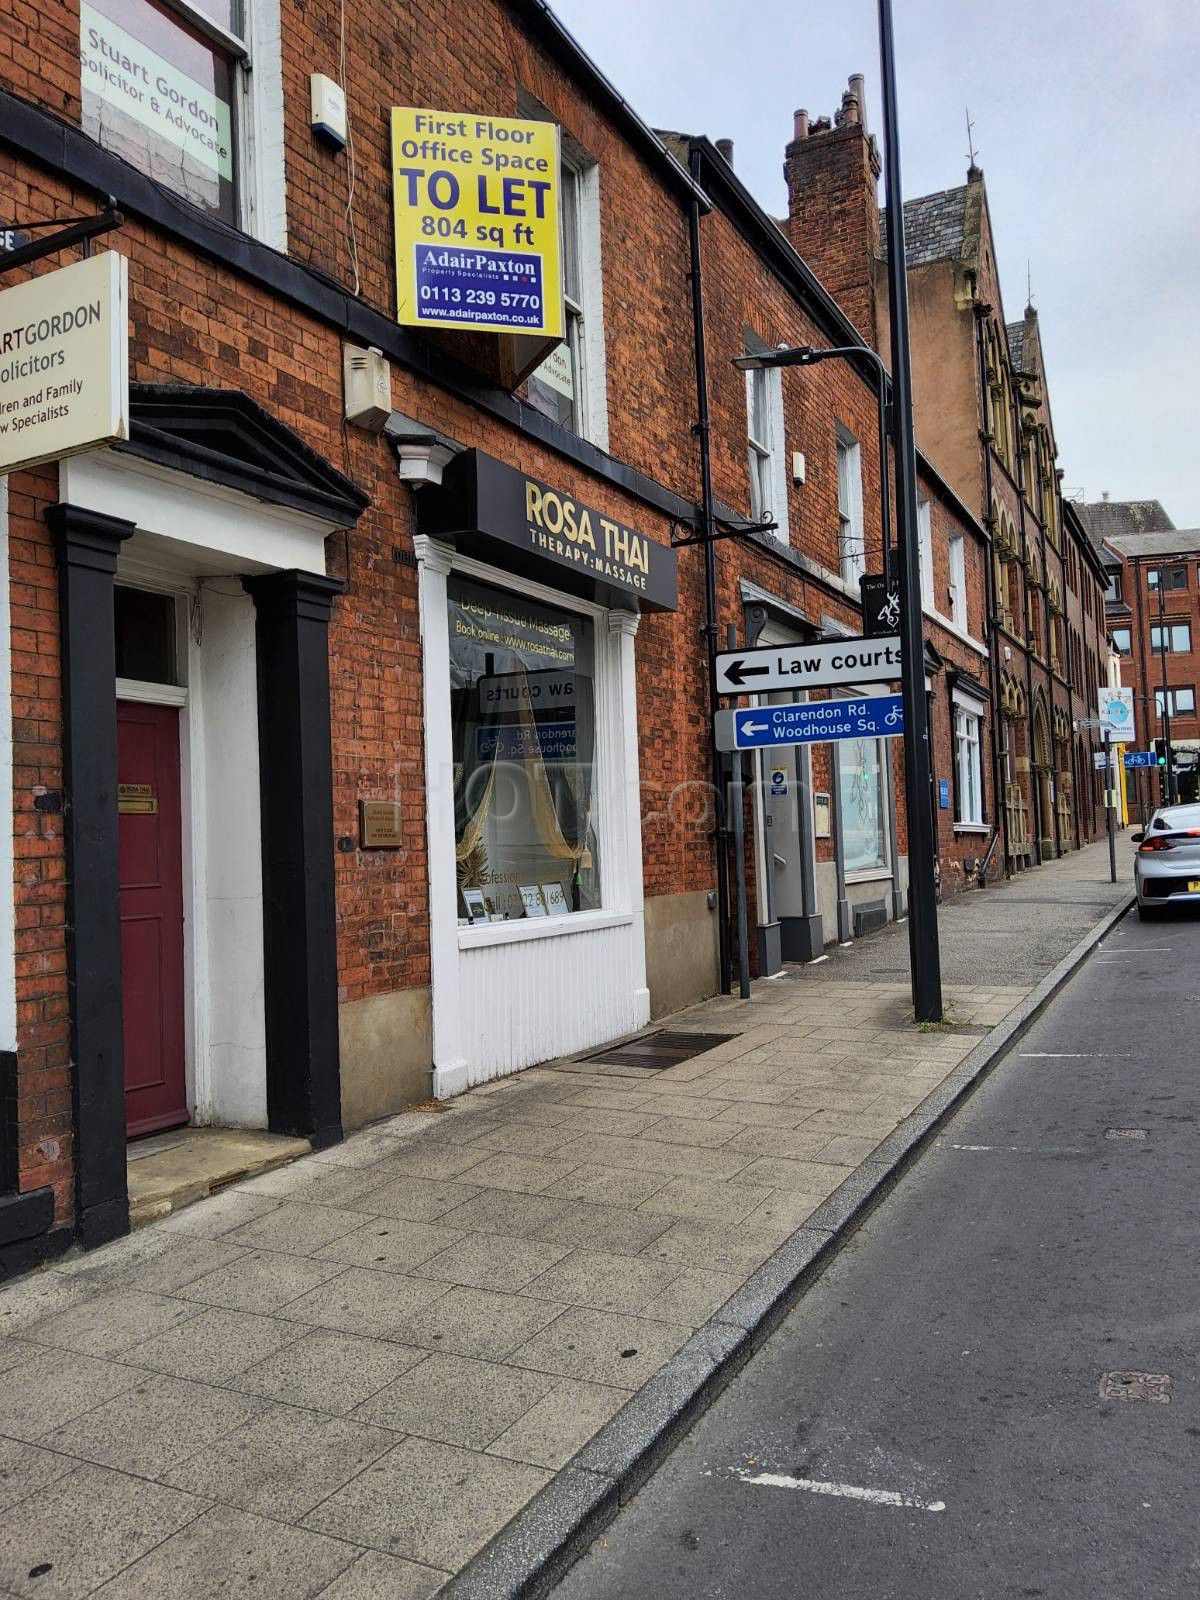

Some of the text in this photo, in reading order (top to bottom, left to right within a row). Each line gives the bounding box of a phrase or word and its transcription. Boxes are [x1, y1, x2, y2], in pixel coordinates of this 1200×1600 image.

[88, 28, 219, 132] Stuart Gordon
[80, 50, 227, 159] Solicitor & Advocate
[415, 115, 535, 144] First Floor
[401, 140, 549, 172] Office Space
[400, 168, 551, 219] TO LET
[422, 216, 534, 248] 804 sq ft
[422, 268, 499, 280] Property Specialists
[423, 250, 535, 275] AdairPaxton
[421, 286, 540, 309] 0113 239 5770
[0, 300, 101, 354] RTGORDON
[422, 307, 540, 324] www.adairpaxton.co.uk
[0, 350, 65, 383] olicitors
[23, 389, 43, 408] and
[46, 378, 83, 401] Family
[12, 404, 69, 433] Specialists
[526, 480, 649, 575] ROSA THAI
[456, 620, 476, 637] Book
[461, 597, 492, 619] Deep
[529, 616, 571, 642] Massage
[778, 646, 902, 675] Law courts
[773, 704, 870, 724] Clarendon Rd.
[773, 719, 880, 738] Woodhouse Sq.
